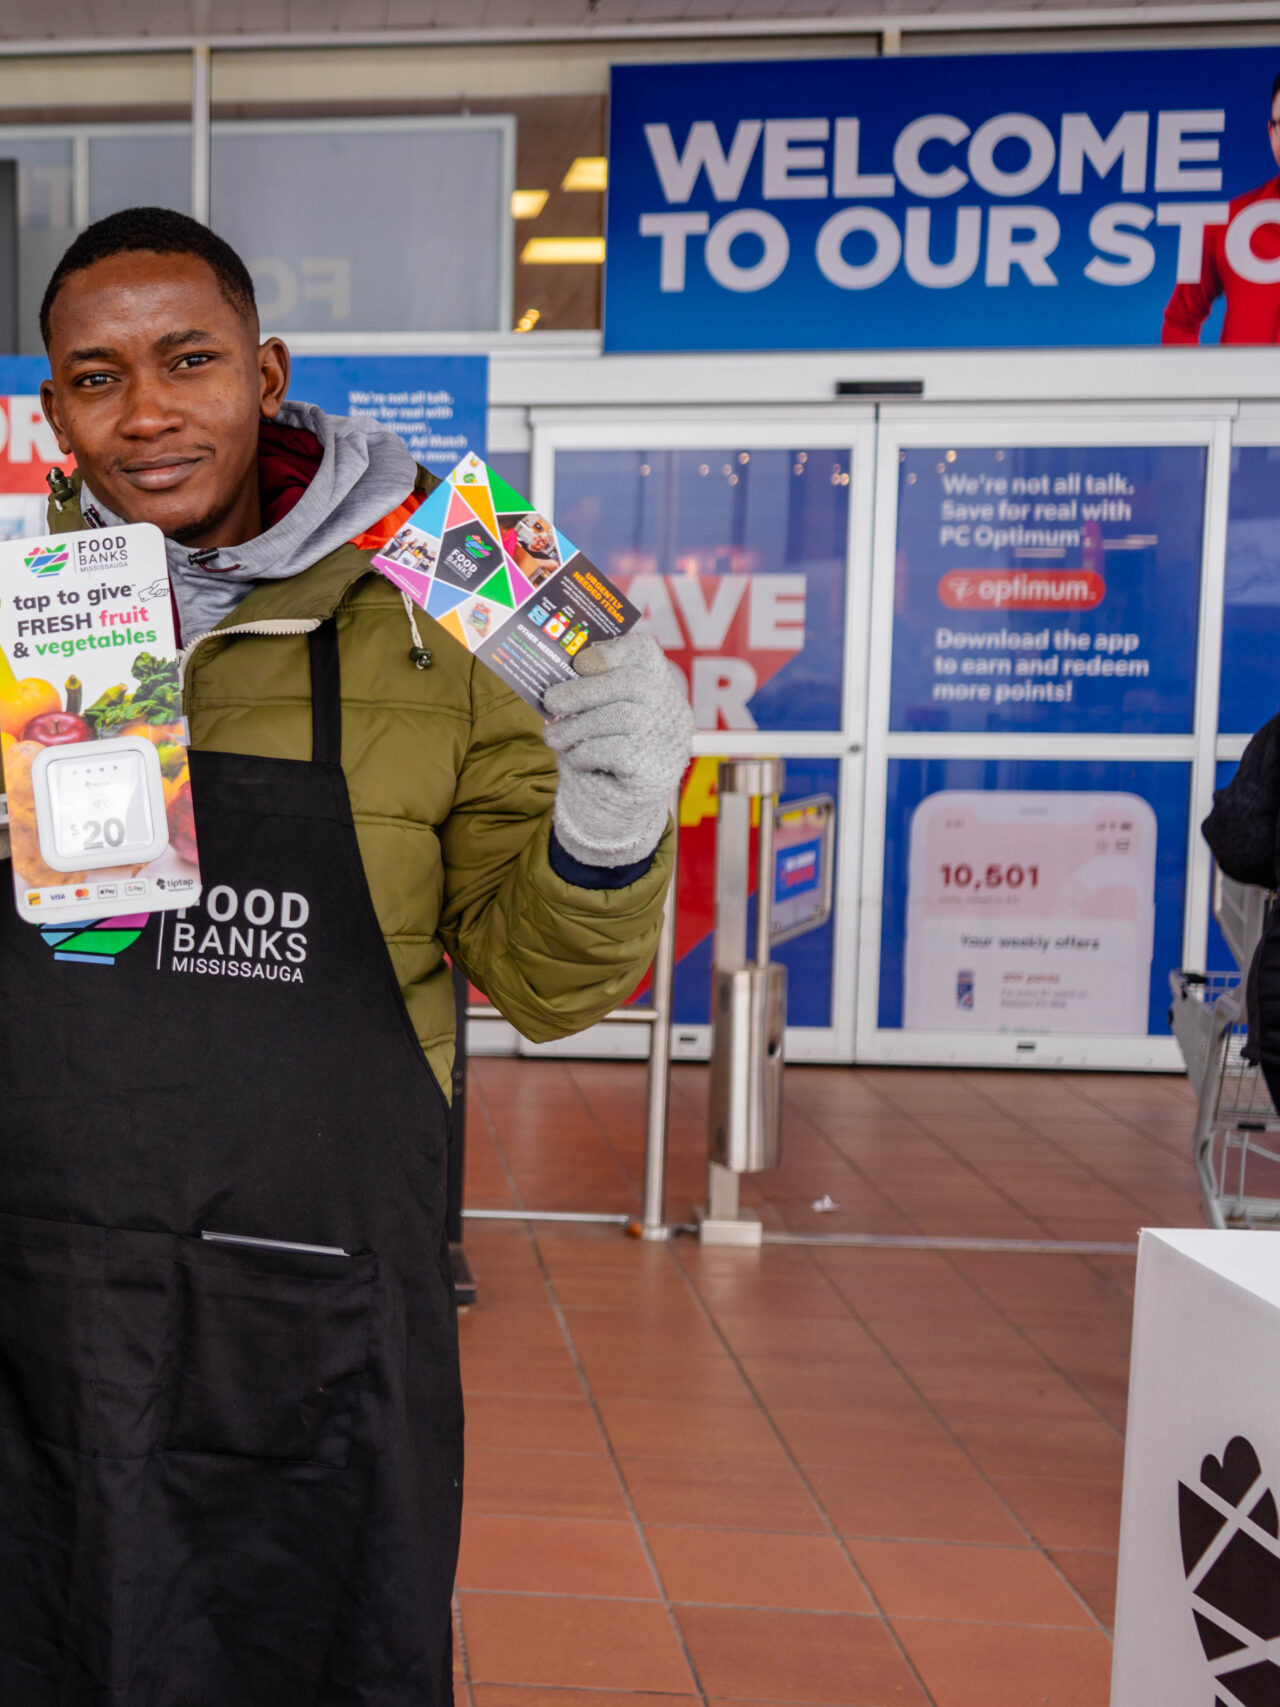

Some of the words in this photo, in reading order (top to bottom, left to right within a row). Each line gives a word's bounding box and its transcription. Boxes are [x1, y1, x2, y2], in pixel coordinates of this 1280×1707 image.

[644, 109, 1225, 203] WELCOME
[639, 208, 790, 293] TO
[815, 205, 1060, 291] OUR
[388, 391, 408, 404] not
[411, 390, 425, 404] all
[380, 405, 397, 419] for
[400, 405, 424, 419] real
[426, 405, 453, 419] with
[943, 474, 1007, 495] We're
[1013, 475, 1050, 495] not
[1054, 473, 1080, 495] all
[1085, 473, 1135, 496] talk.
[941, 500, 994, 521] Save
[998, 499, 1031, 521] for
[1035, 499, 1078, 521] real
[1082, 499, 1132, 521] with
[77, 536, 127, 554] FOOD
[940, 527, 969, 547] PC
[79, 550, 129, 566] BANKS
[80, 561, 129, 573] MISSISSAUGA
[446, 555, 474, 580] BANKS
[451, 548, 478, 574] FOOD
[13, 593, 51, 612] tap
[57, 590, 80, 606] to
[571, 570, 602, 601] NEEDED
[599, 598, 625, 624] ITEMS
[584, 571, 623, 611] URGENTLY
[17, 612, 92, 638] FRESH
[99, 606, 149, 627] fruit
[625, 573, 808, 651] AVE
[13, 642, 30, 659] &
[35, 628, 157, 658] vegetables
[516, 622, 539, 644] OTHER
[536, 640, 562, 664] NEEDED
[936, 628, 1049, 650] Download
[1053, 628, 1092, 650] the
[1095, 633, 1139, 655] app
[934, 656, 958, 677] to
[961, 660, 1011, 677] earn
[1016, 655, 1059, 677] and
[1063, 656, 1149, 678] redeem
[933, 684, 990, 701] more
[995, 680, 1073, 704] points!
[166, 877, 194, 889] tiptap
[940, 864, 1039, 891] 10,501
[50, 893, 66, 902] VISA
[173, 922, 308, 963] BANKS
[172, 956, 304, 983] MISSISSAUGA
